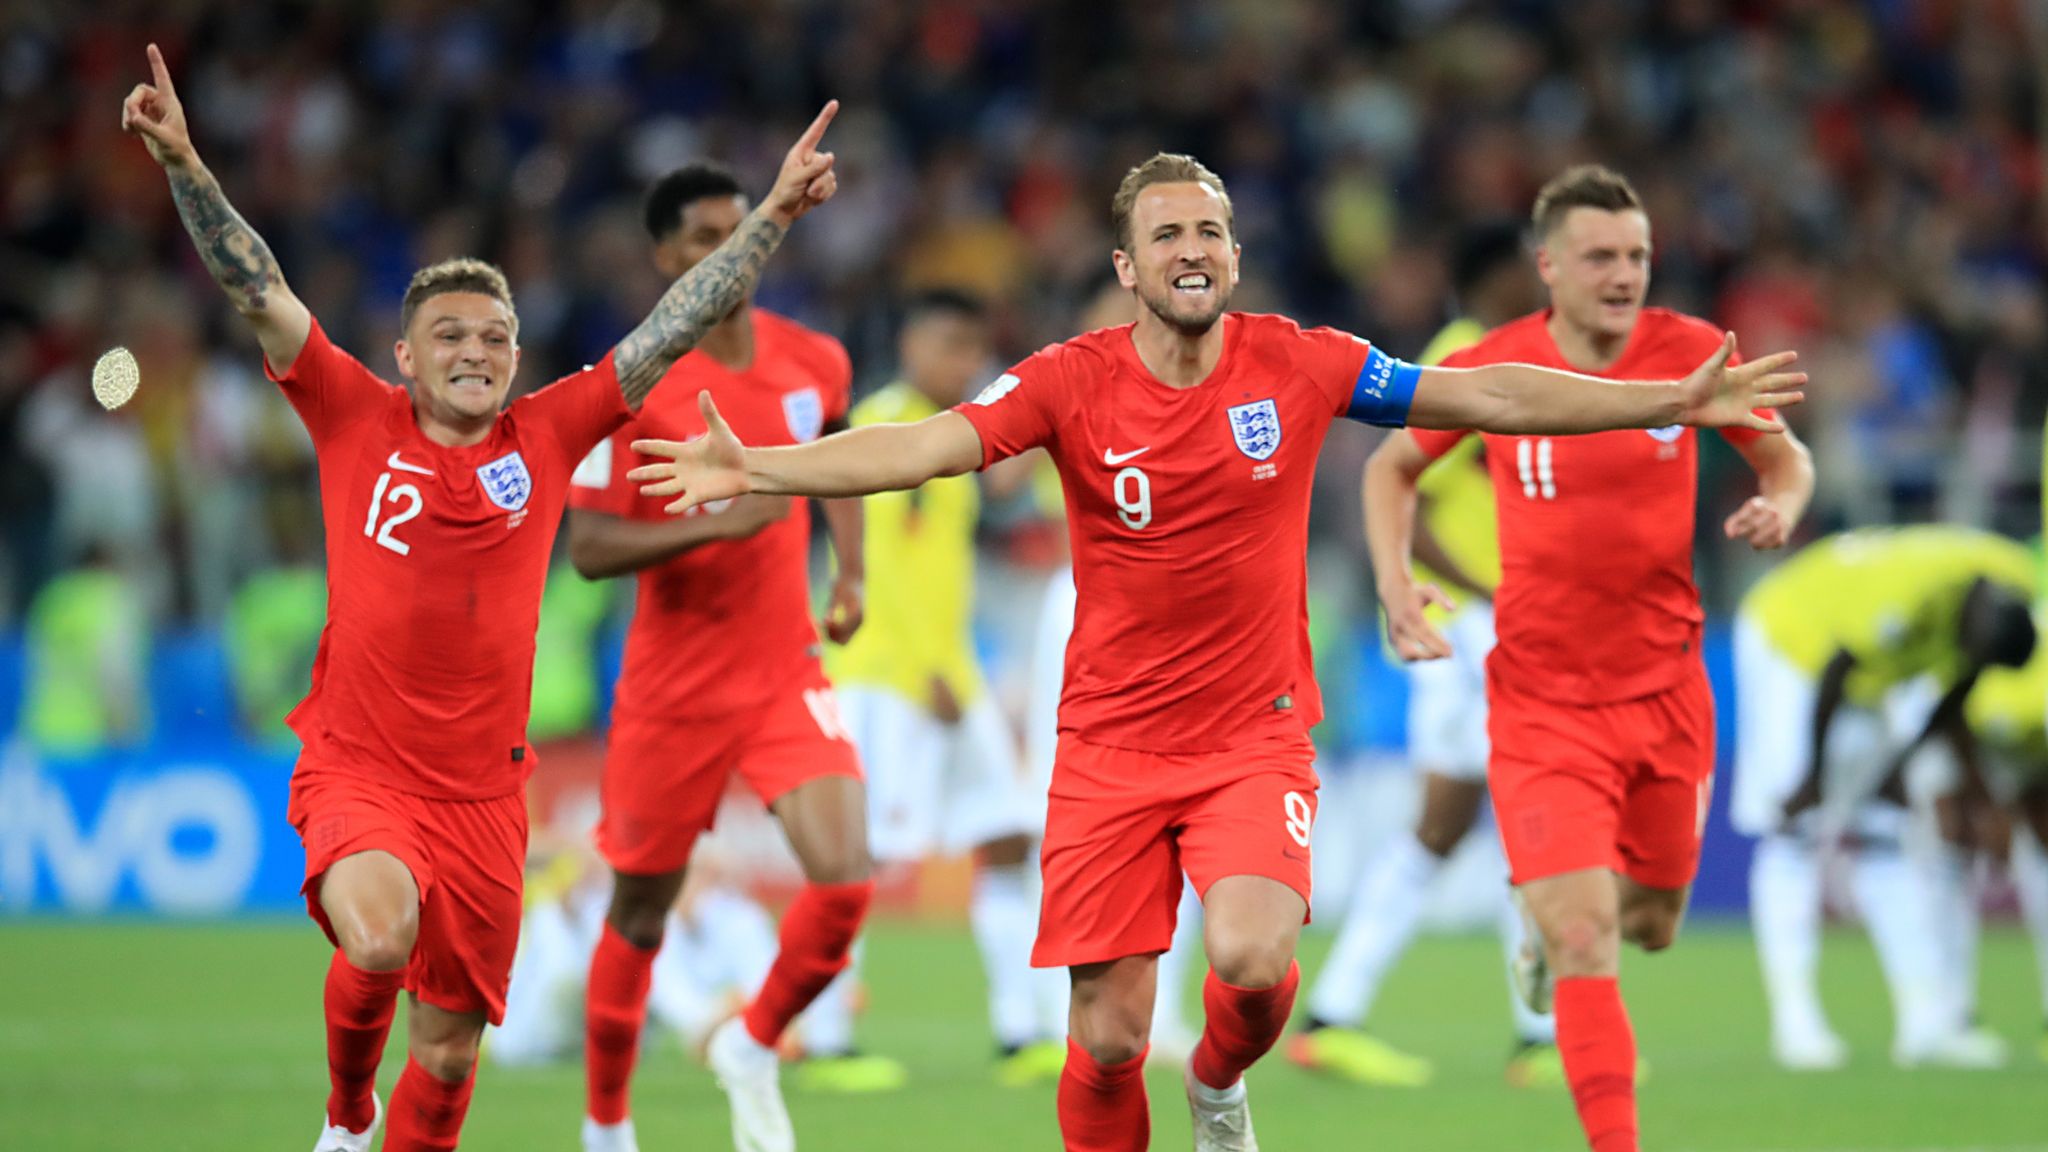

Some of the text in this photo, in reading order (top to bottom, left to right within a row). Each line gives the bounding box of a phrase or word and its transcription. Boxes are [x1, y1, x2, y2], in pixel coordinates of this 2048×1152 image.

[1113, 466, 1152, 531] 9
[1517, 438, 1556, 500] 11
[364, 472, 423, 556] 12
[1284, 790, 1311, 848] 9
